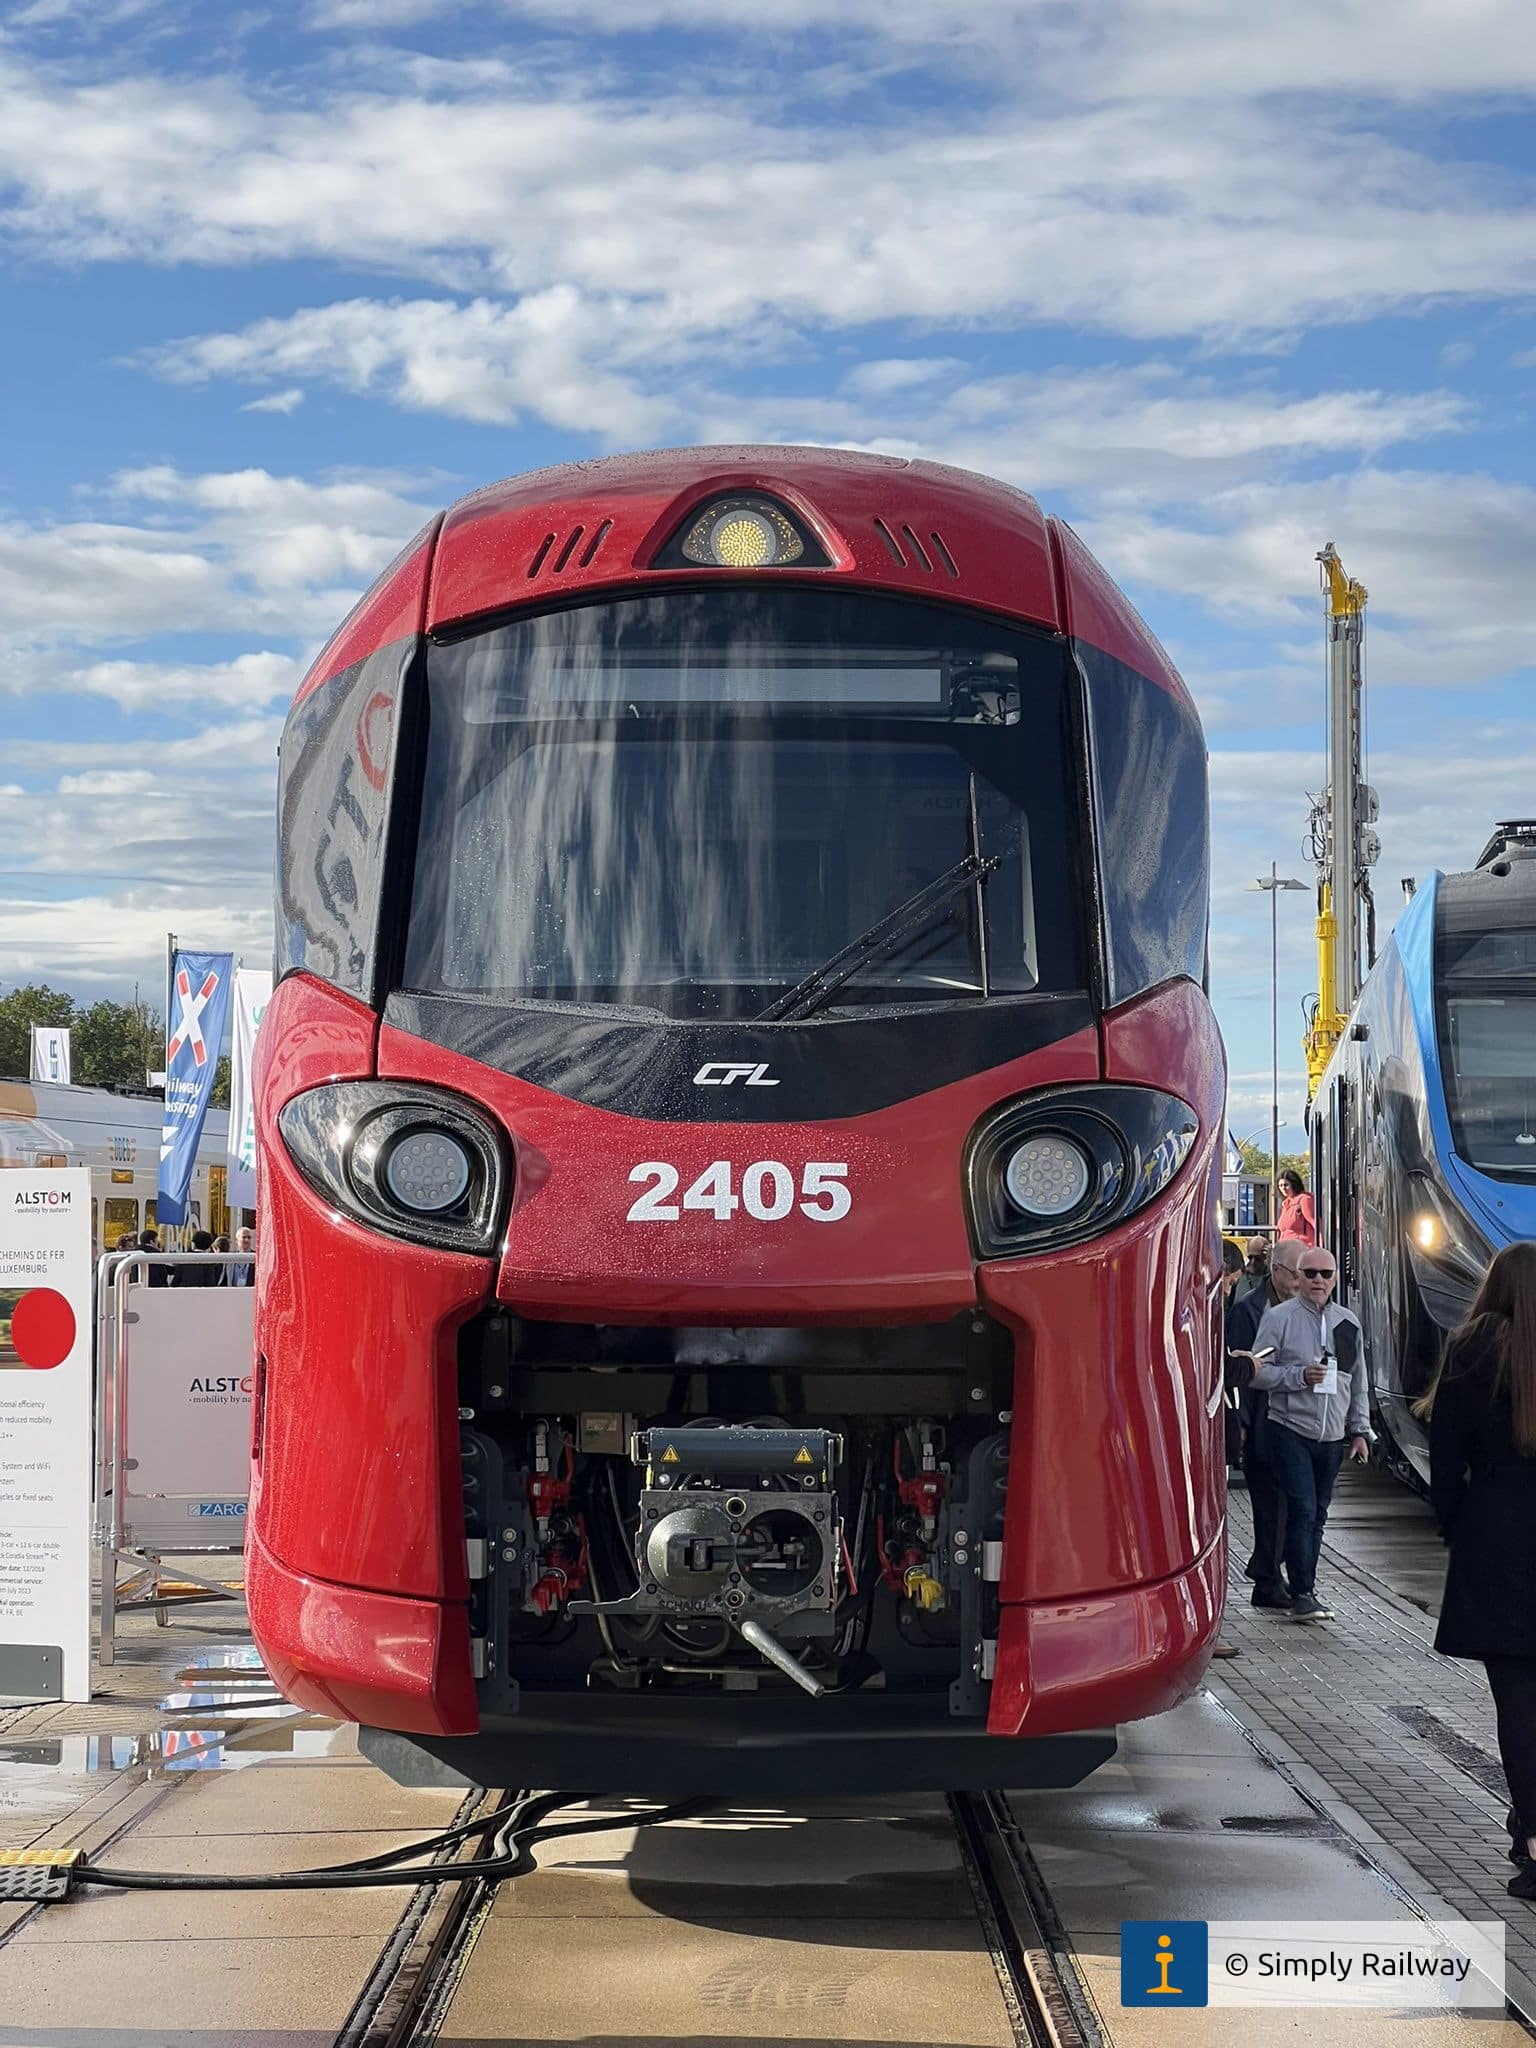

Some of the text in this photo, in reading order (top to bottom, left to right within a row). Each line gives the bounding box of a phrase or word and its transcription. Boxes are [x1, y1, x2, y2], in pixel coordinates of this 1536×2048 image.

[693, 1063, 781, 1085] CFL
[626, 1160, 852, 1222] 2405
[15, 1190, 71, 1205] ALSTOM
[37, 1250, 47, 1260] DE
[49, 1250, 65, 1260] FER
[193, 1395, 229, 1405] mobility
[230, 1395, 241, 1405] by
[5, 1416, 28, 1424] reduced
[29, 1416, 52, 1425] mobility
[2, 1462, 23, 1471] System
[24, 1462, 36, 1470] and
